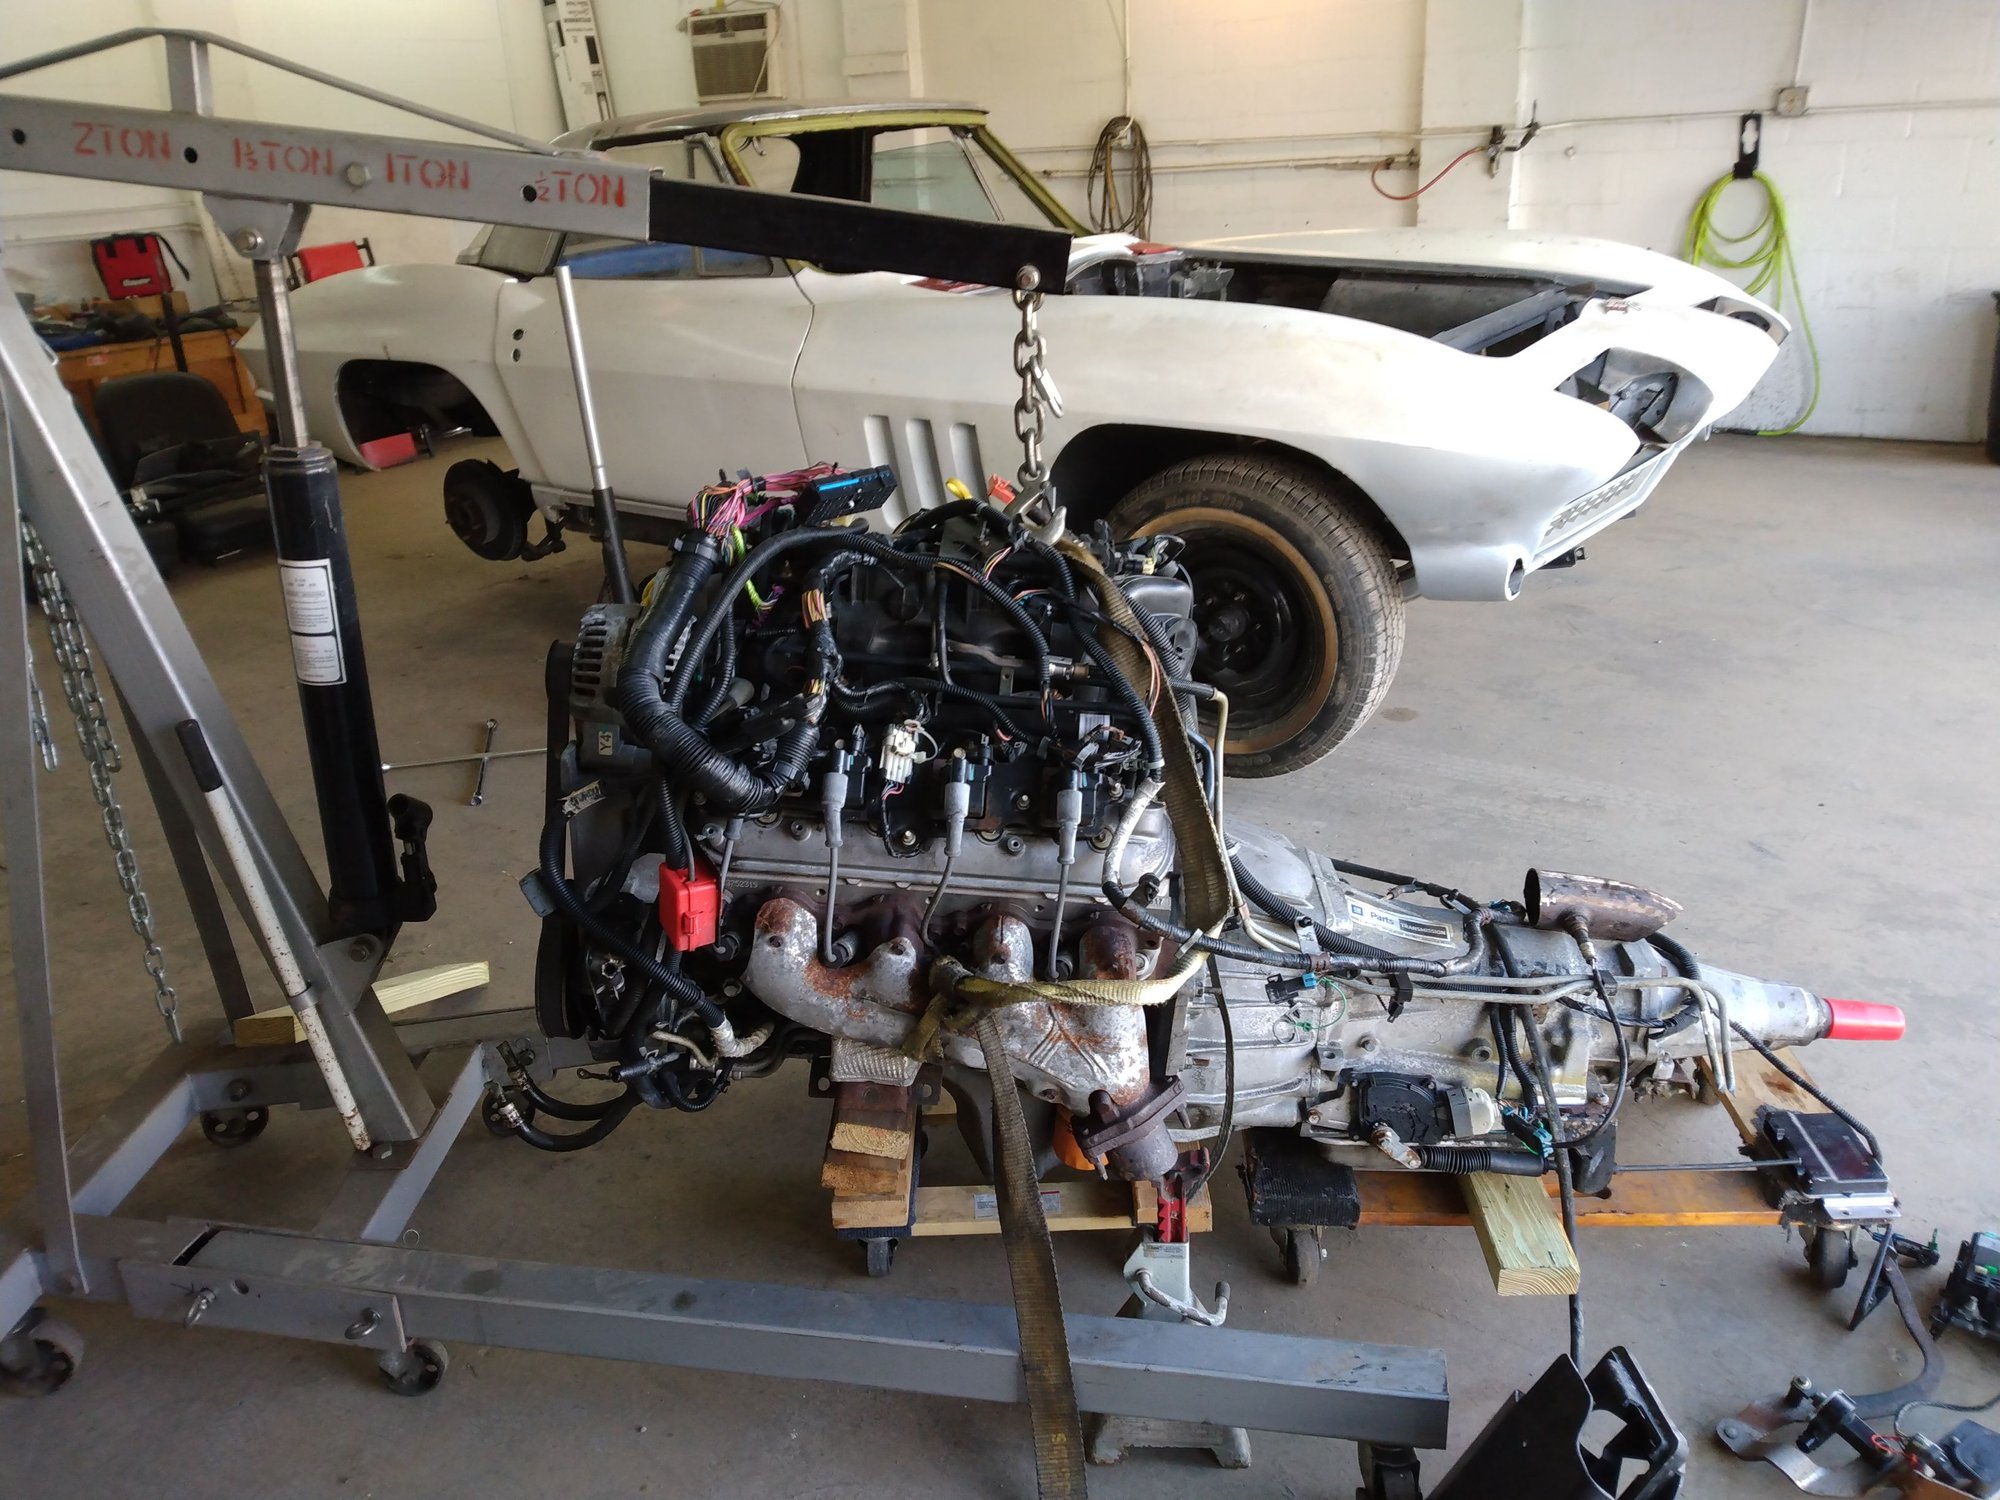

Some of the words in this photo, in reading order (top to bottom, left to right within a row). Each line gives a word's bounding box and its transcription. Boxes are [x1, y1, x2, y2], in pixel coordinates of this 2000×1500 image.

[600, 734, 612, 751] Y4
[1370, 911, 1395, 925] Parts
[1400, 922, 1446, 936] TRANSMISSION
